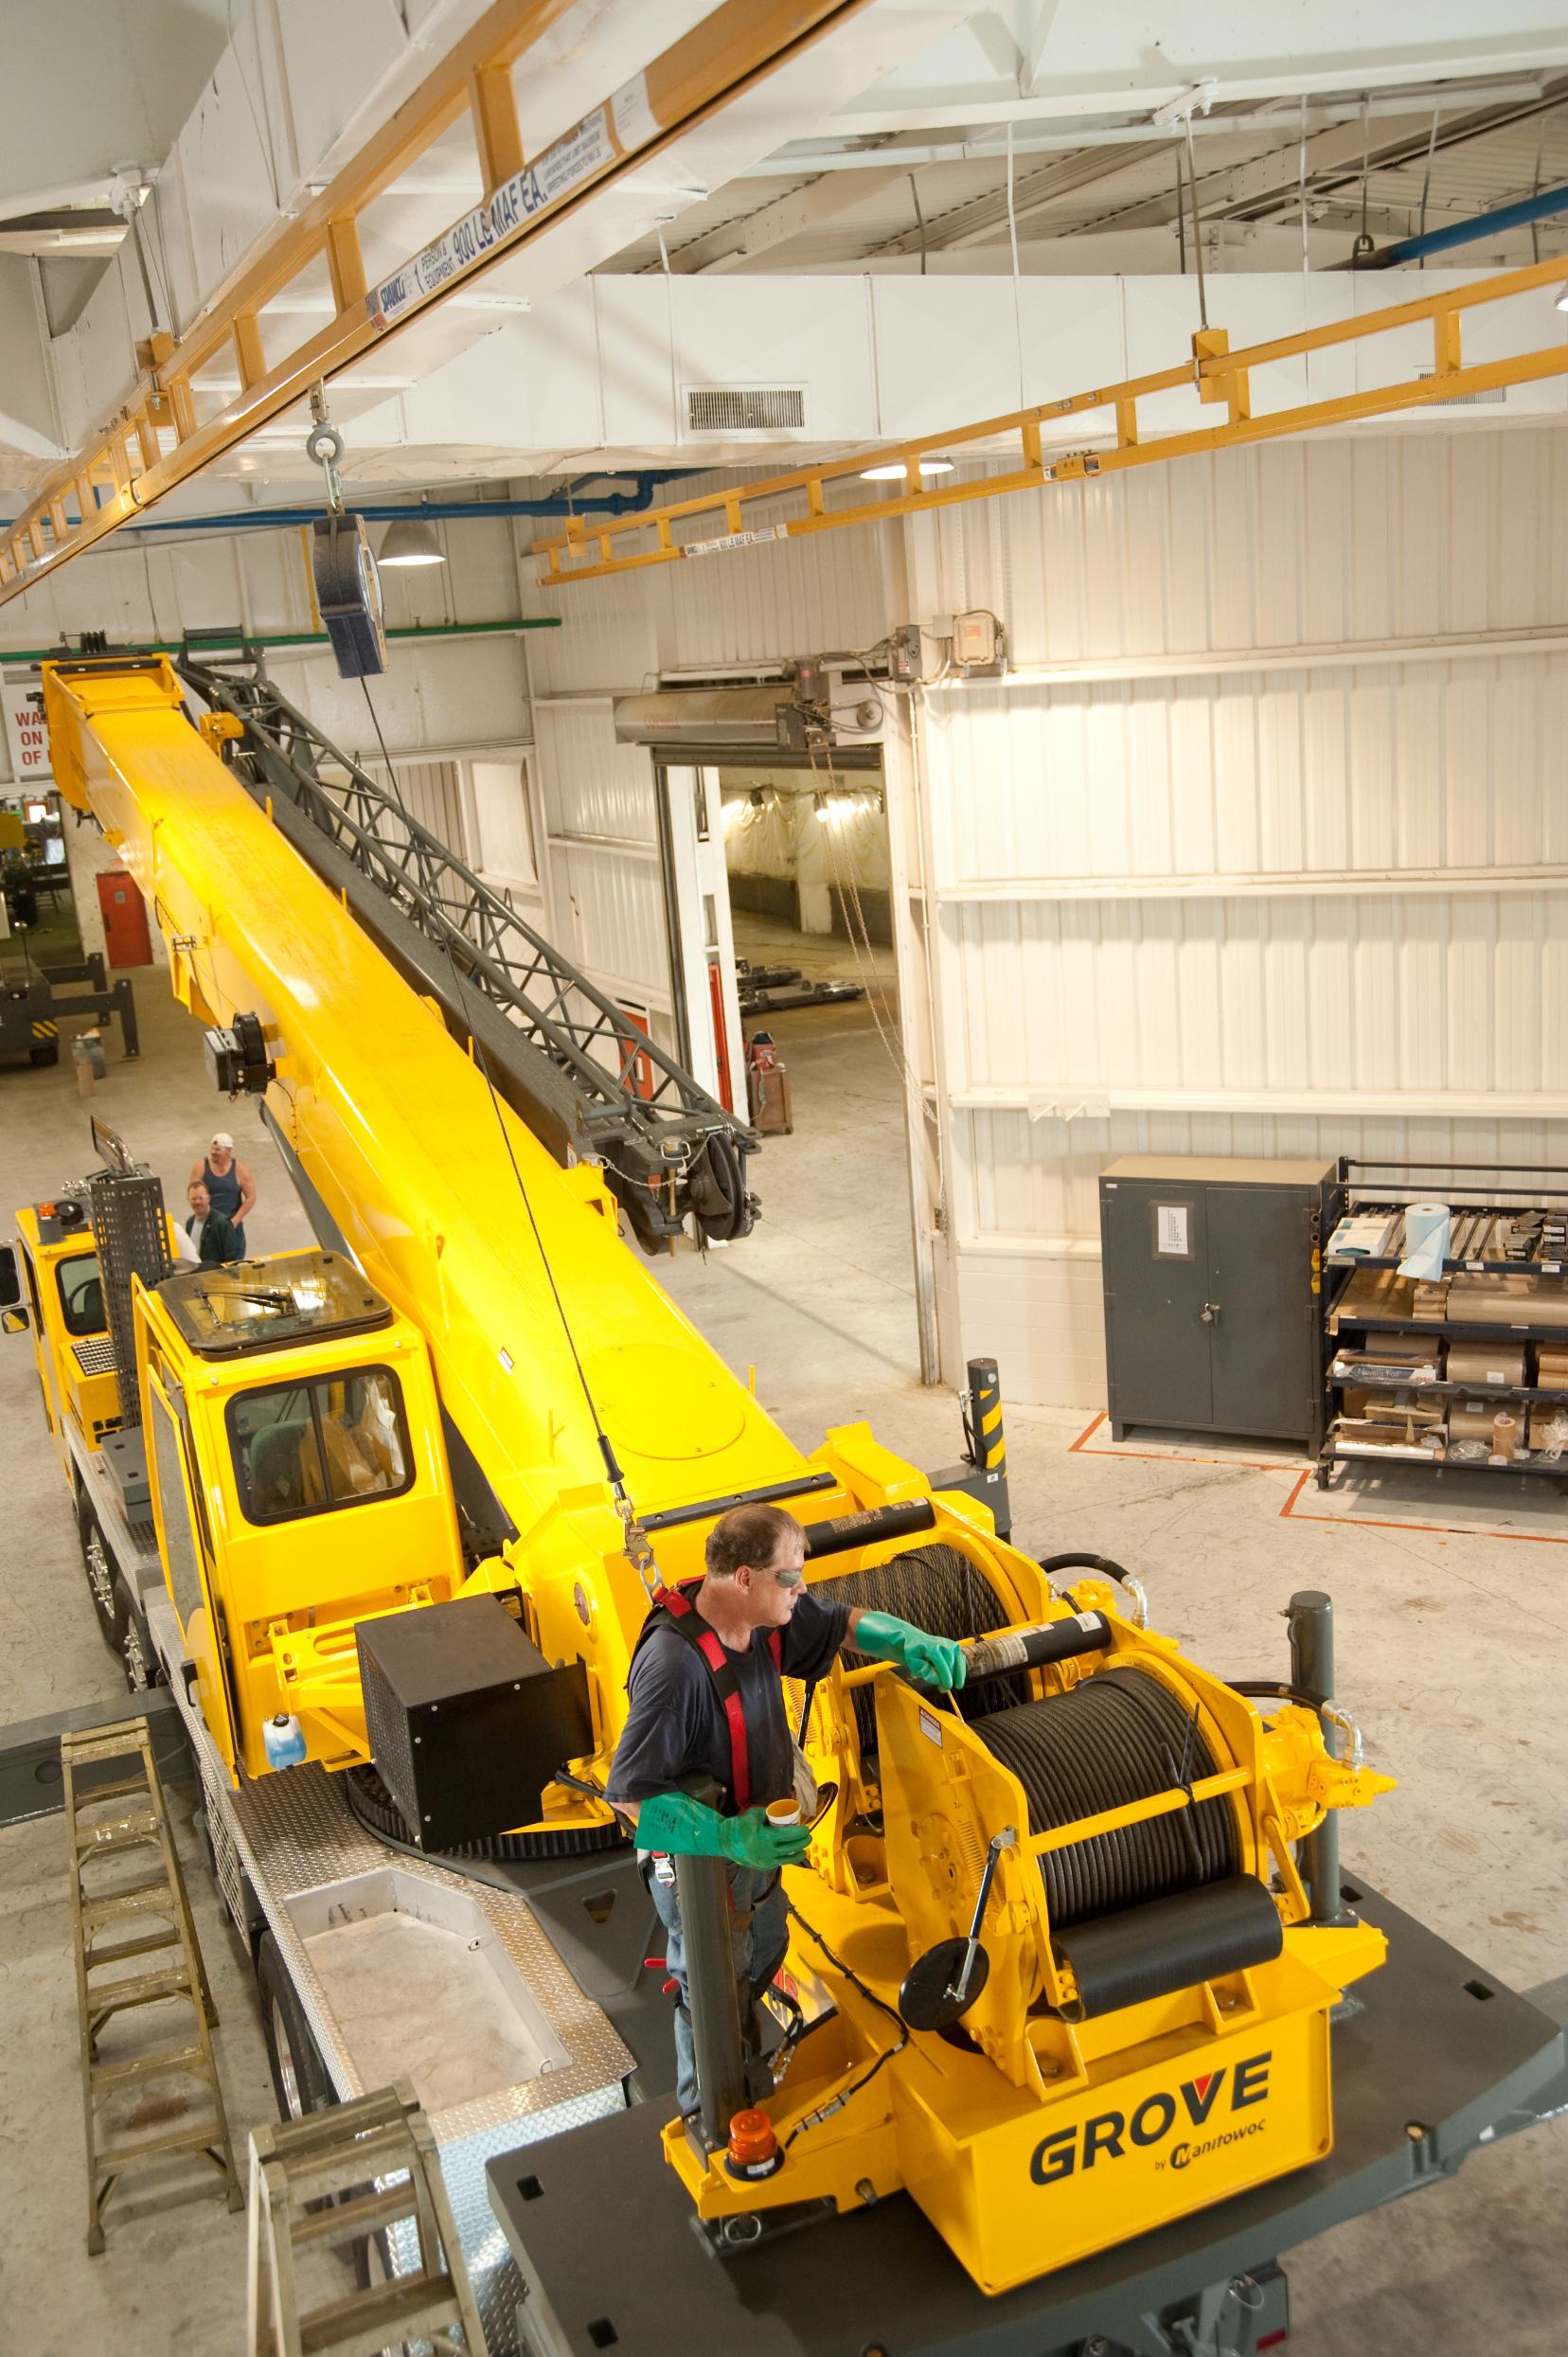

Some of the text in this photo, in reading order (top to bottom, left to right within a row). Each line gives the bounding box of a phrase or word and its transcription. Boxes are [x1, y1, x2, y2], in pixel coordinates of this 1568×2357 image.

[453, 222, 476, 265] 900
[491, 182, 519, 239] MAF
[520, 164, 548, 213] EA.
[421, 246, 442, 273] PERSON
[424, 257, 456, 291] EQUIPMENT
[414, 263, 425, 295] 1
[21, 730, 43, 746] ON
[22, 750, 42, 766] OF
[1030, 2050, 1273, 2186] GROVE
[1154, 2118, 1266, 2170] by Manitowoc
